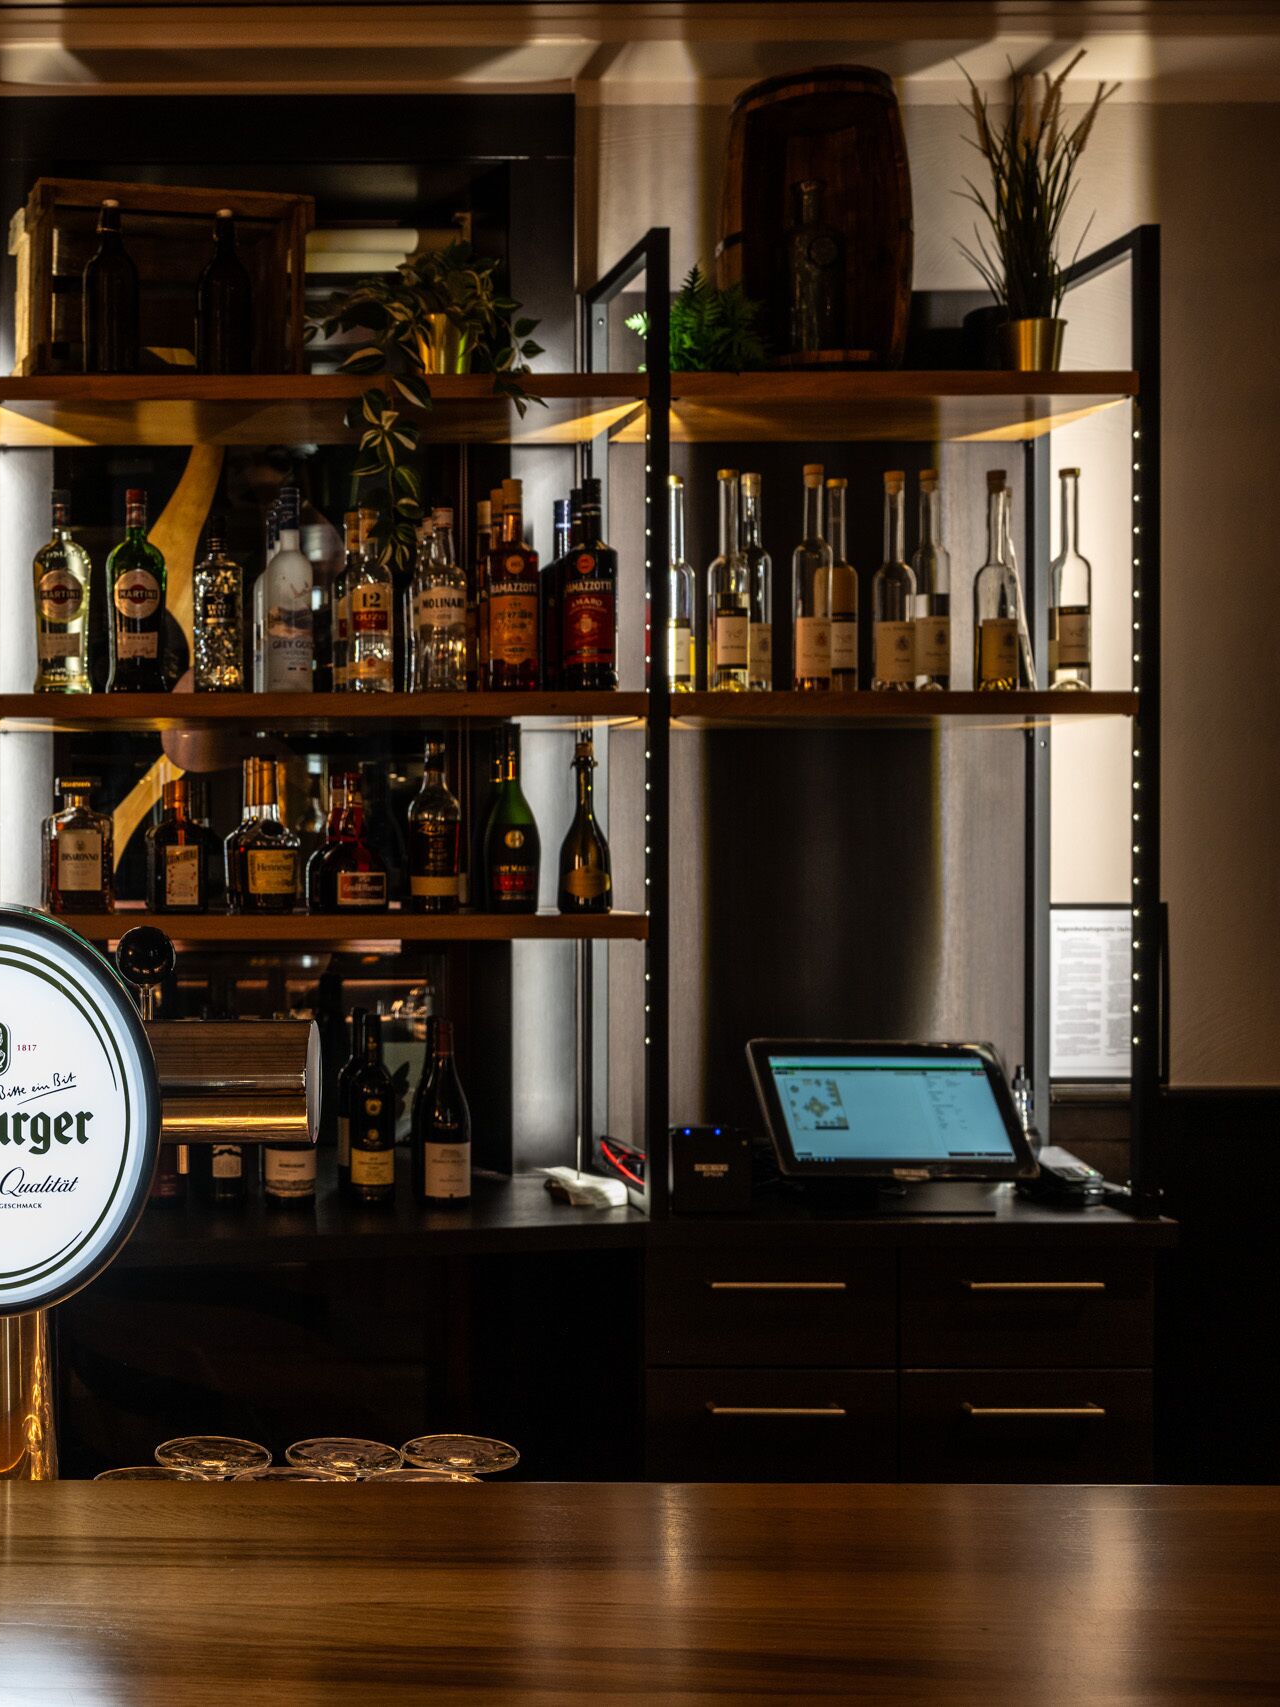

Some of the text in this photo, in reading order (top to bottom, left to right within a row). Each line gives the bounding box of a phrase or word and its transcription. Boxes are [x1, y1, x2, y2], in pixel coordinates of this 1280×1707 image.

[119, 590, 157, 598] MARTINI
[362, 593, 381, 607] 12
[355, 613, 385, 621] OUZO
[62, 853, 99, 861] DISARONNO
[16, 1044, 38, 1052] 1817
[31, 1082, 50, 1092] ein
[53, 1072, 76, 1088] Bit
[0, 1166, 80, 1197] Qualität
